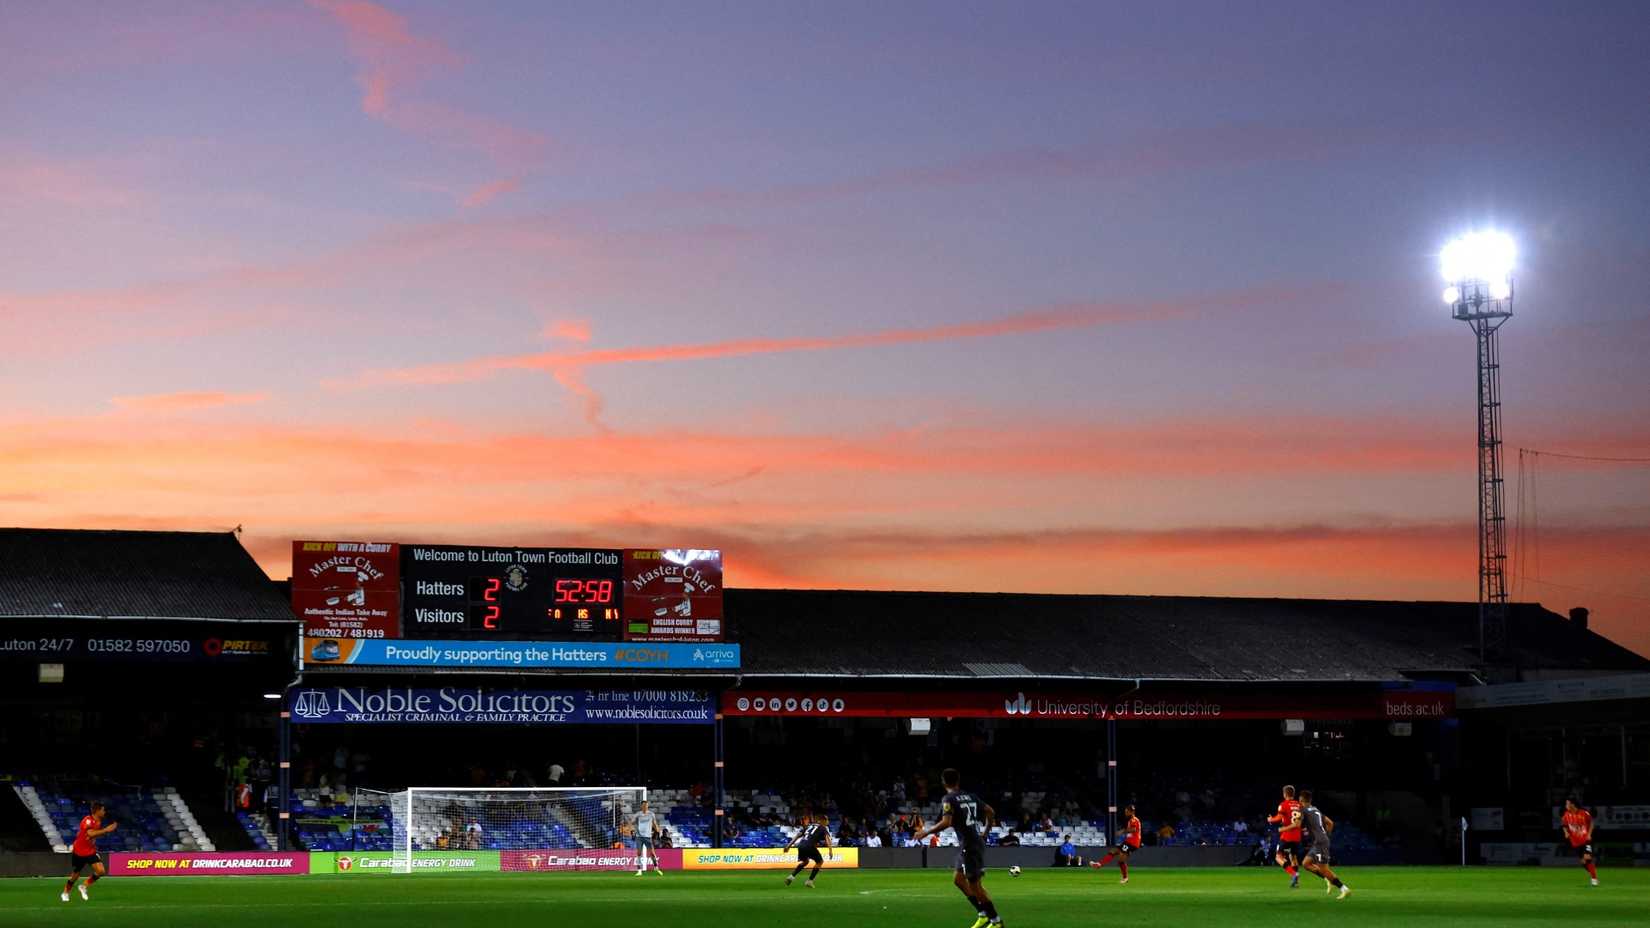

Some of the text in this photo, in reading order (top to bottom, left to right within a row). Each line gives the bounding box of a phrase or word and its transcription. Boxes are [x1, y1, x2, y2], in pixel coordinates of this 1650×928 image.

[337, 544, 358, 552] WITH
[358, 544, 364, 552] A
[365, 544, 392, 552] CURRY
[413, 549, 619, 565] Welcome to Luton Town Football Club
[308, 556, 384, 580] Master Chef
[631, 565, 716, 593] Master Chef
[416, 581, 465, 596] Hatters
[484, 578, 500, 602] 2
[555, 580, 612, 603] 52:58
[304, 608, 334, 616] Authentic
[371, 609, 388, 617] Away
[415, 608, 465, 623] Visitors
[484, 606, 500, 629] 2
[350, 629, 385, 638] 481919
[40, 638, 74, 651] 24/7
[88, 638, 133, 652] 01582
[136, 639, 190, 653] 597050
[386, 646, 441, 663] Proudly
[444, 647, 522, 664] supporting
[525, 647, 549, 661] the
[552, 648, 607, 661] Hatters
[705, 649, 734, 659] arriva
[333, 687, 575, 713] Noble Solicitors
[585, 705, 708, 720] www.noblesolicitors.co.uk
[1037, 699, 1221, 718] University of Bedfordshire
[1386, 700, 1444, 716] beds.ac.uk
[345, 713, 567, 722] SPECIALIST CRIMINAL & FAMILY PRACTICE
[126, 858, 293, 869] SHOP NOW AT DRINKCARABAO.CO.UK
[412, 858, 447, 868] ENERGY
[448, 858, 477, 868] DRINK
[548, 855, 596, 866] Carabao
[598, 857, 633, 866] ENERGY
[698, 855, 721, 864] SHOP
[723, 855, 743, 864] NOW
[744, 855, 754, 863] AT
